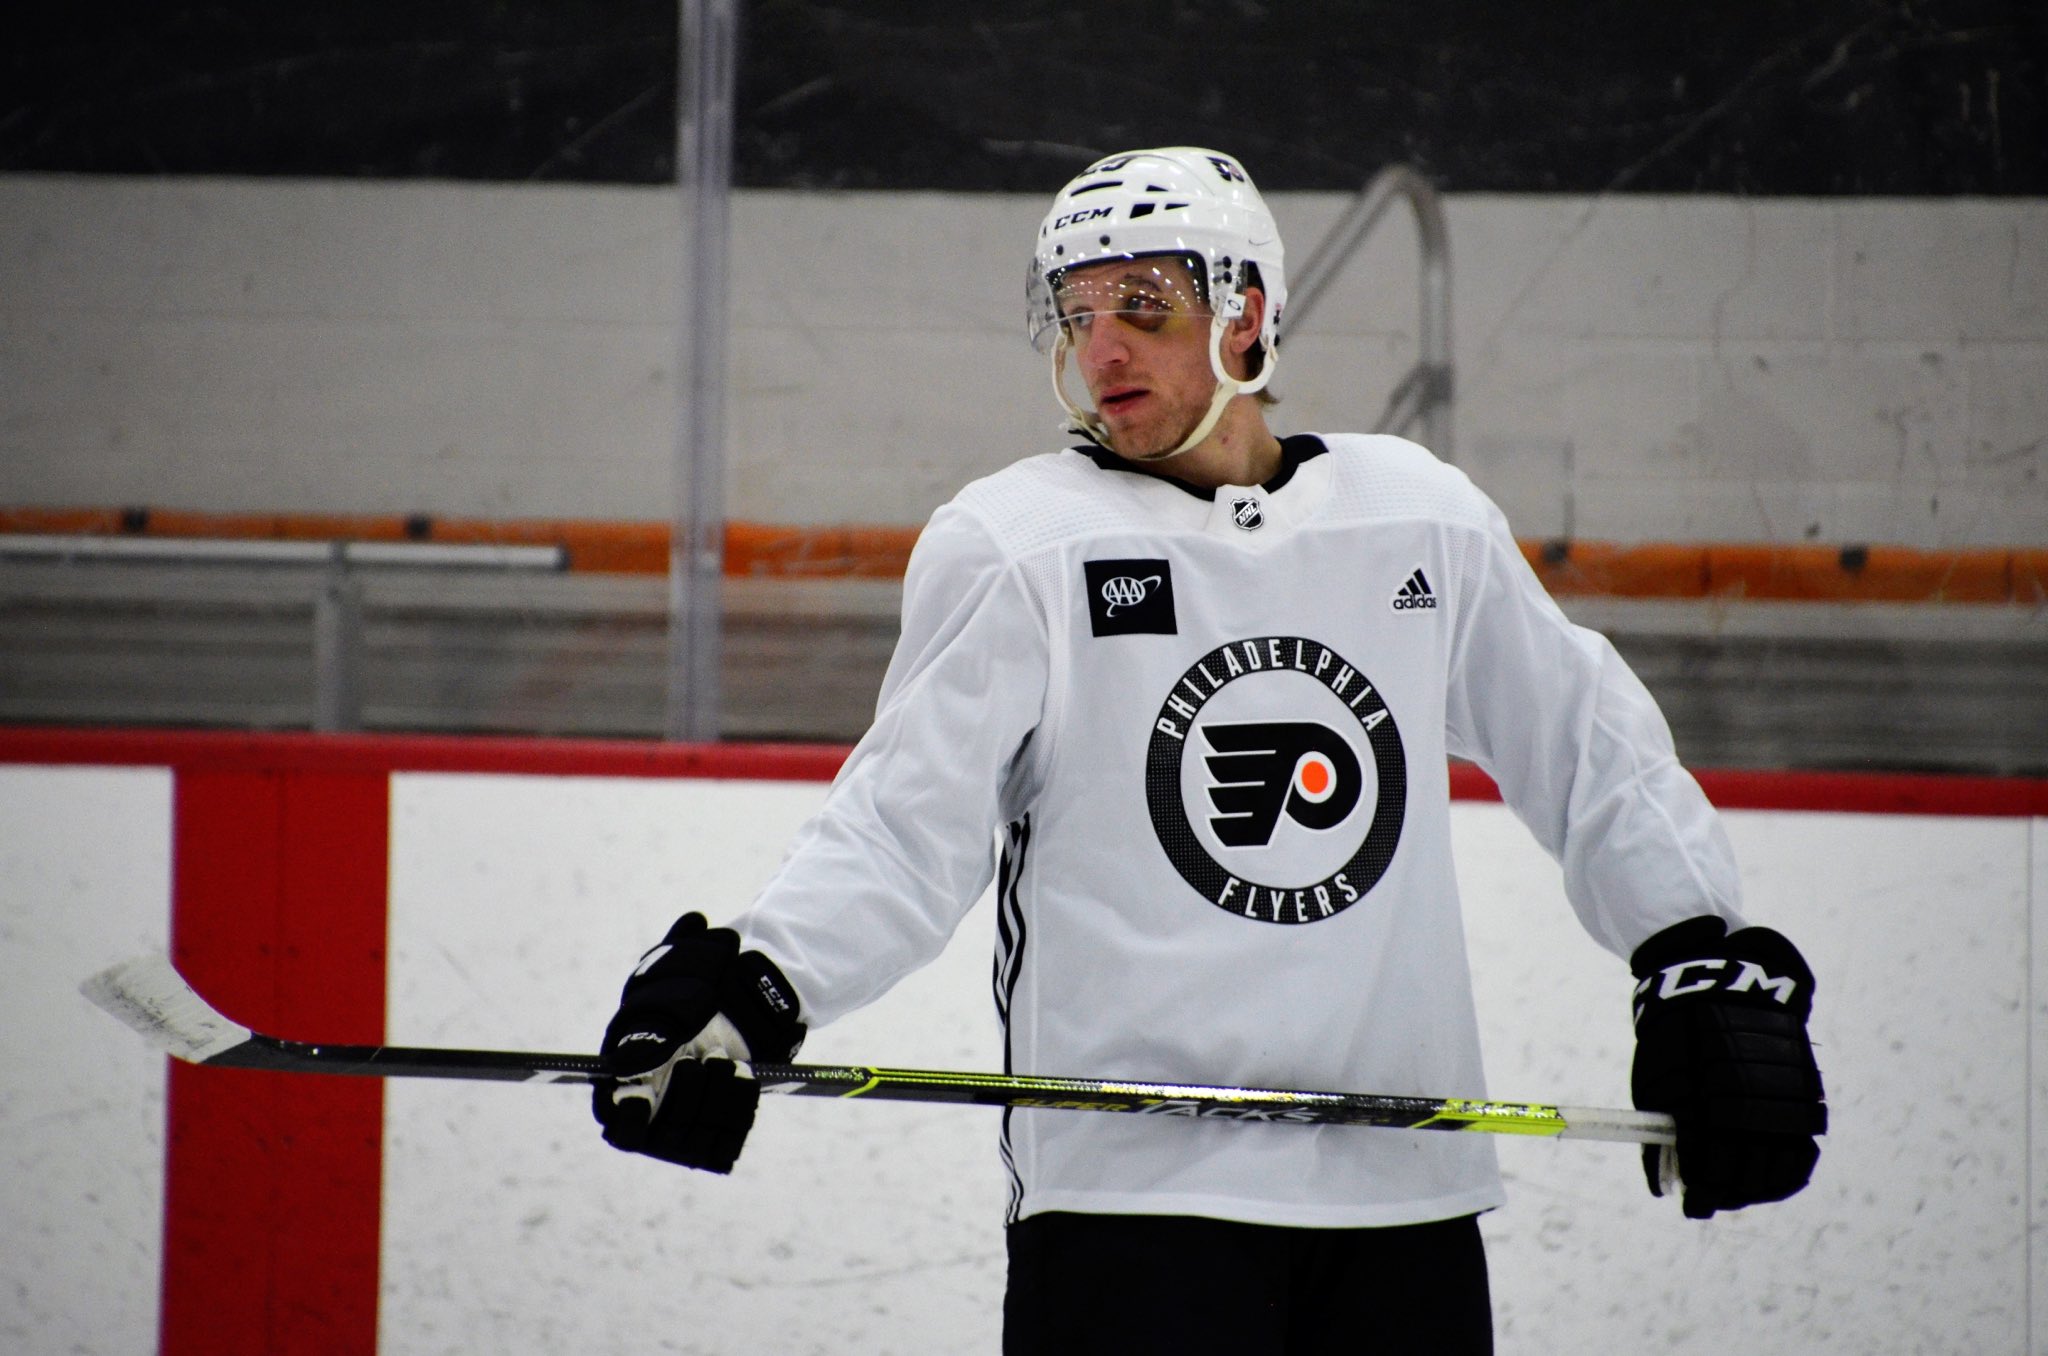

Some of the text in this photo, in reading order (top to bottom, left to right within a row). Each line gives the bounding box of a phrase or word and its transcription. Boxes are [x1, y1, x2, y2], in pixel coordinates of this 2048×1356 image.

[1053, 206, 1114, 230] CCM
[1238, 503, 1257, 525] NHL
[1105, 577, 1143, 606] AAA
[1393, 594, 1437, 610] adidas
[1156, 639, 1388, 739] PHILADELPHIA
[1217, 872, 1358, 922] FLYERS
[760, 975, 790, 1011] CCM
[1136, 1100, 1321, 1123] TACKS
